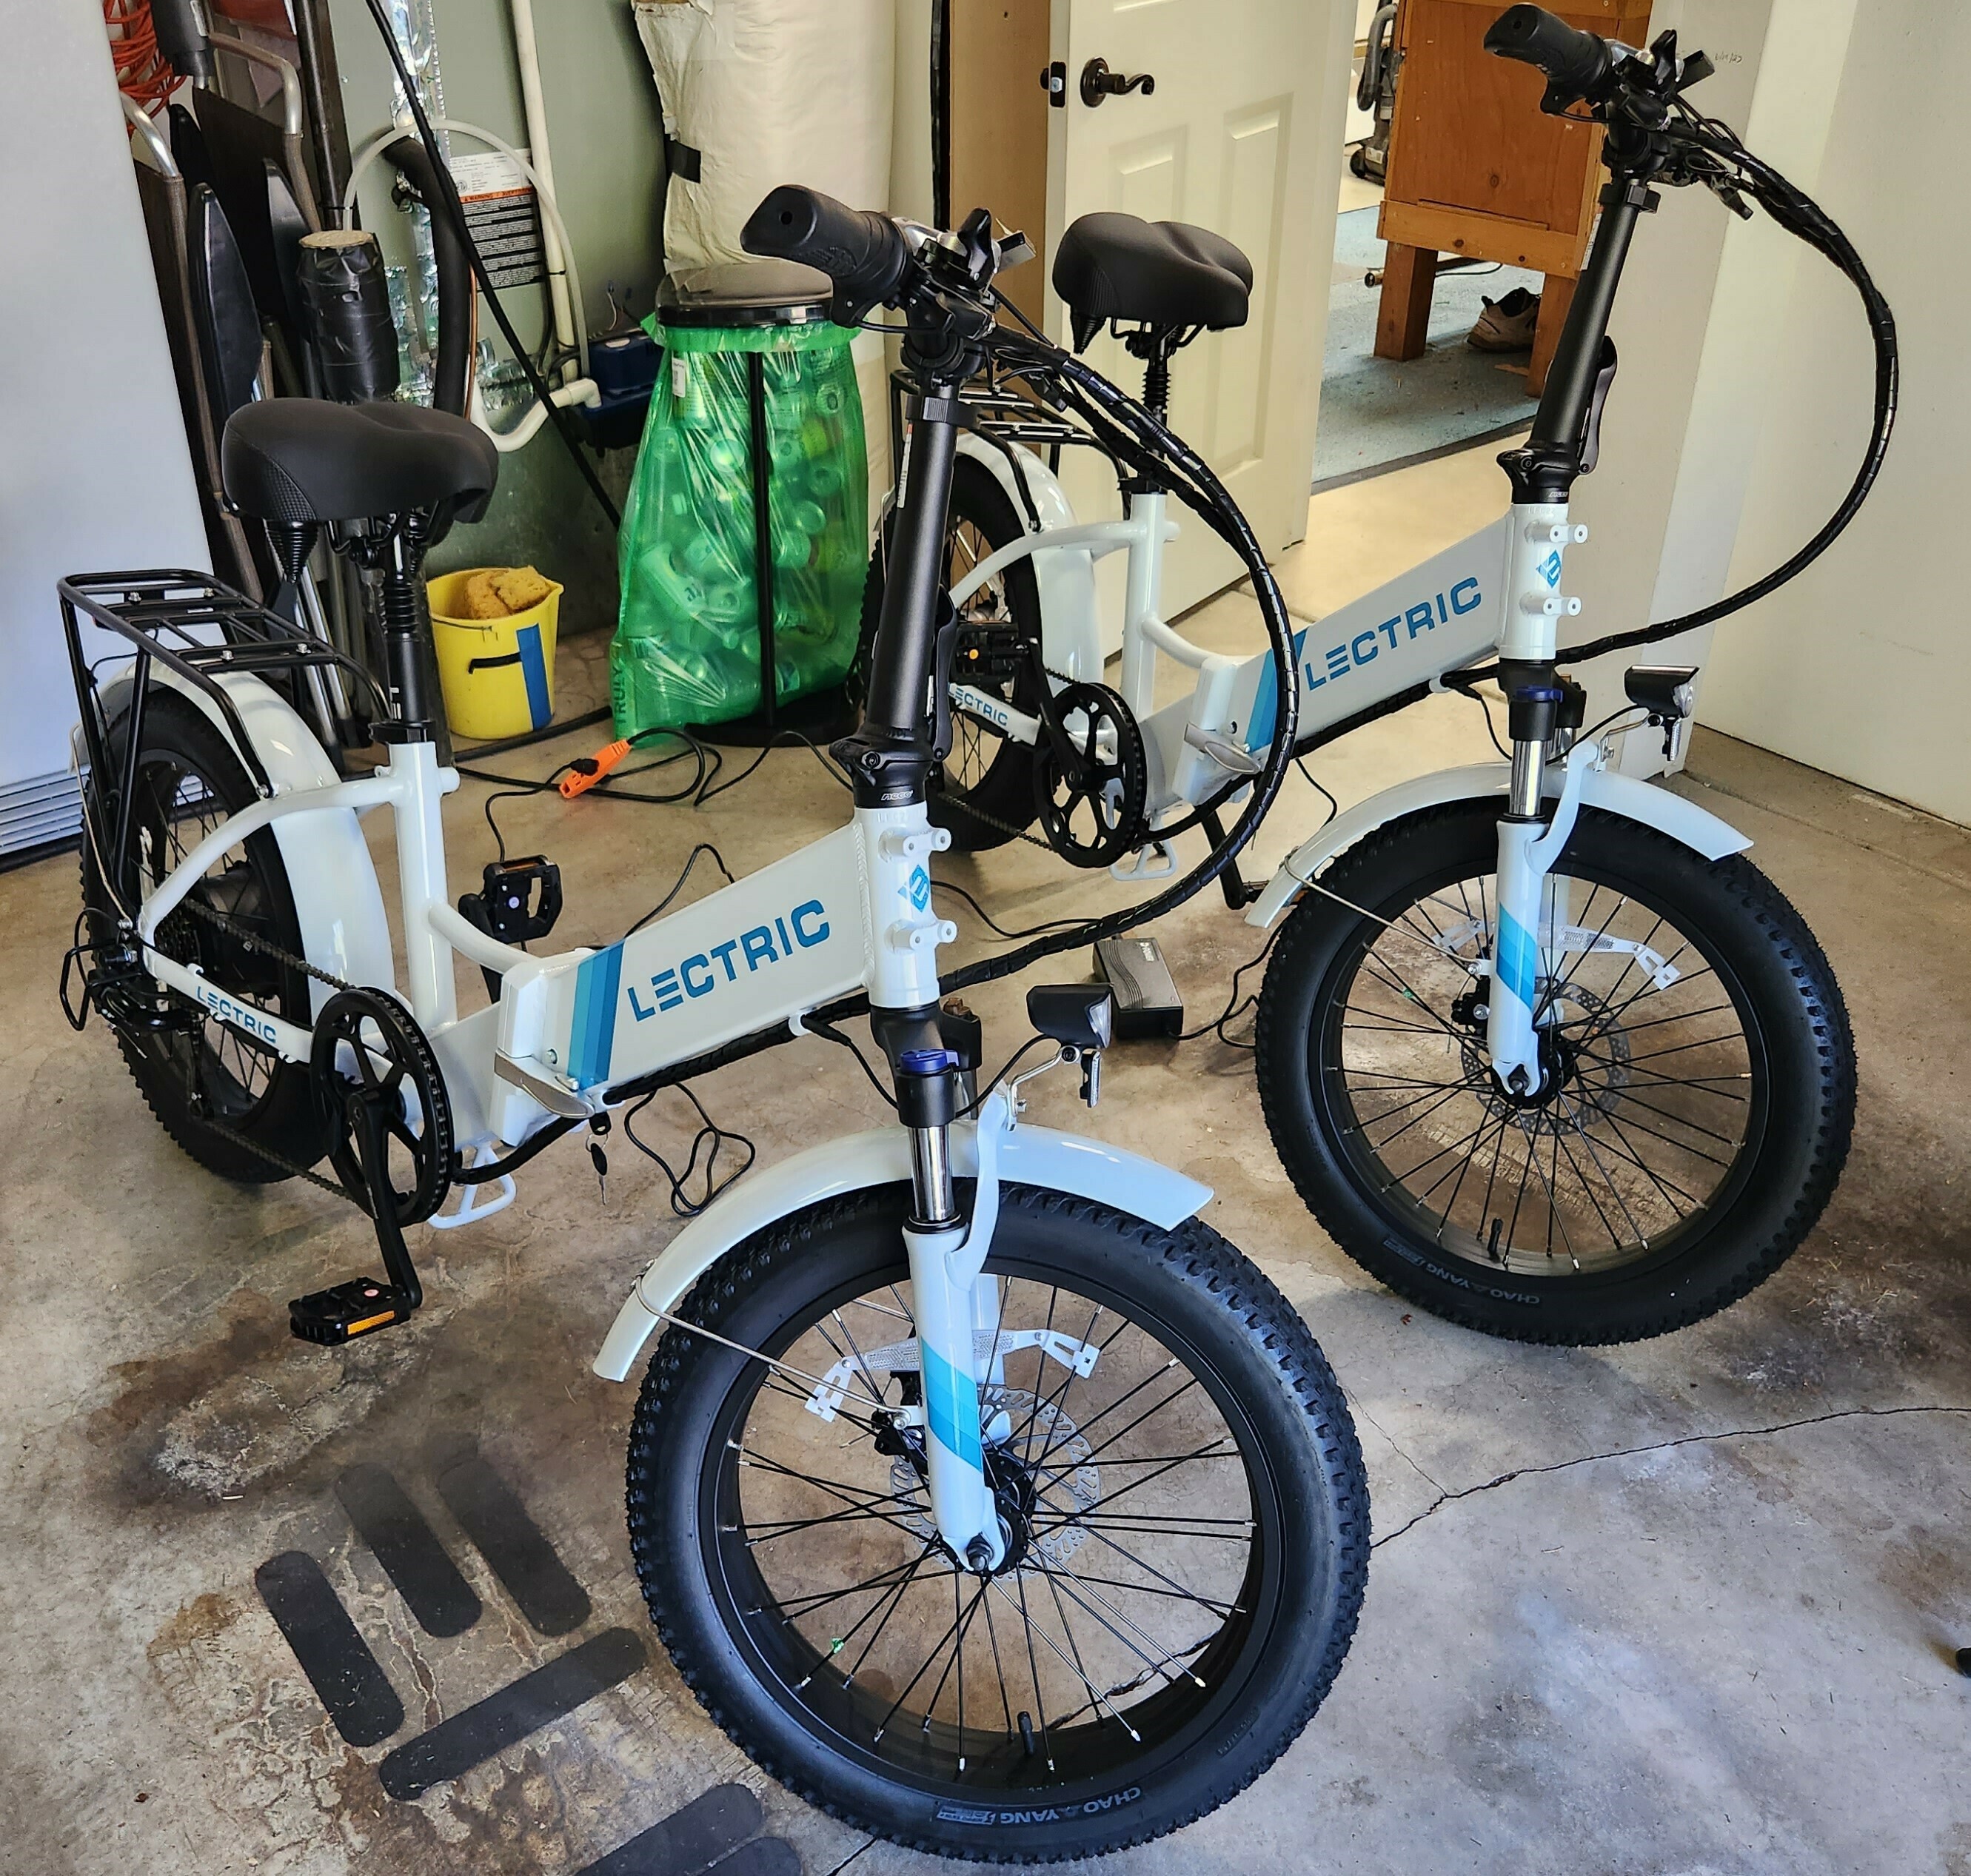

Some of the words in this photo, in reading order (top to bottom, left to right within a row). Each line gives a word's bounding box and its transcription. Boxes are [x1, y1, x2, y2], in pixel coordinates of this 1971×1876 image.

[1305, 577, 1482, 691] LECTRIC
[880, 790, 914, 800] neco
[627, 899, 830, 1022] LECTRIC
[197, 985, 276, 1044] LECTRIC
[1000, 1809, 1060, 1824] YANG
[1082, 1786, 1141, 1813] CHAO
